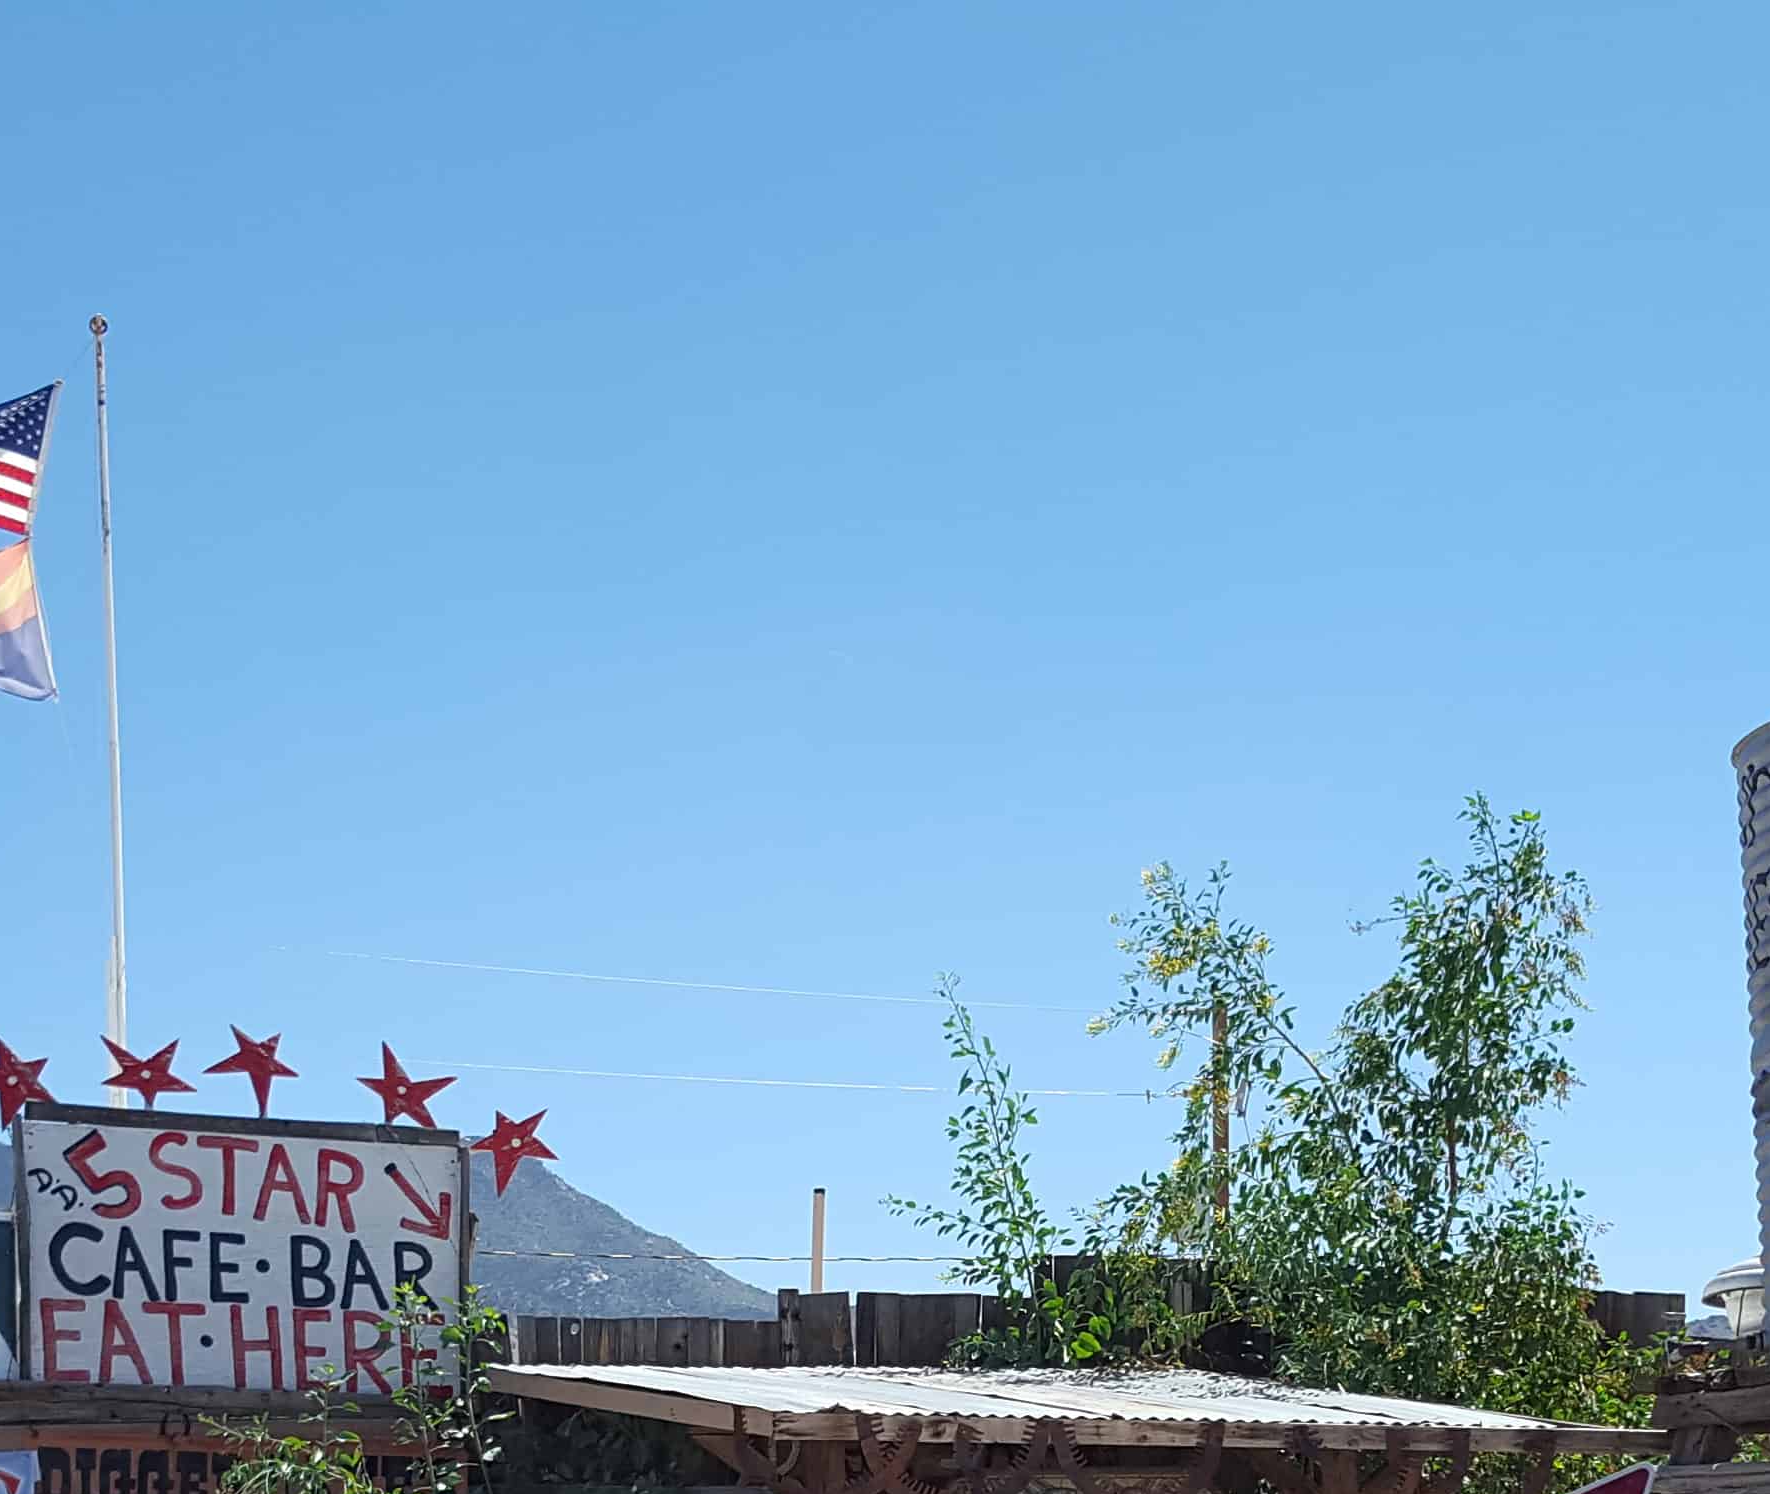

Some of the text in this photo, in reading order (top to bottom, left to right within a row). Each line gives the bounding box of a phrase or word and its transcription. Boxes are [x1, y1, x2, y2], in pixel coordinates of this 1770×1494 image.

[64, 1129, 364, 1233] 5 STAR
[48, 1221, 439, 1311] CAFE BAR
[40, 1297, 454, 1400] EAT HERE
